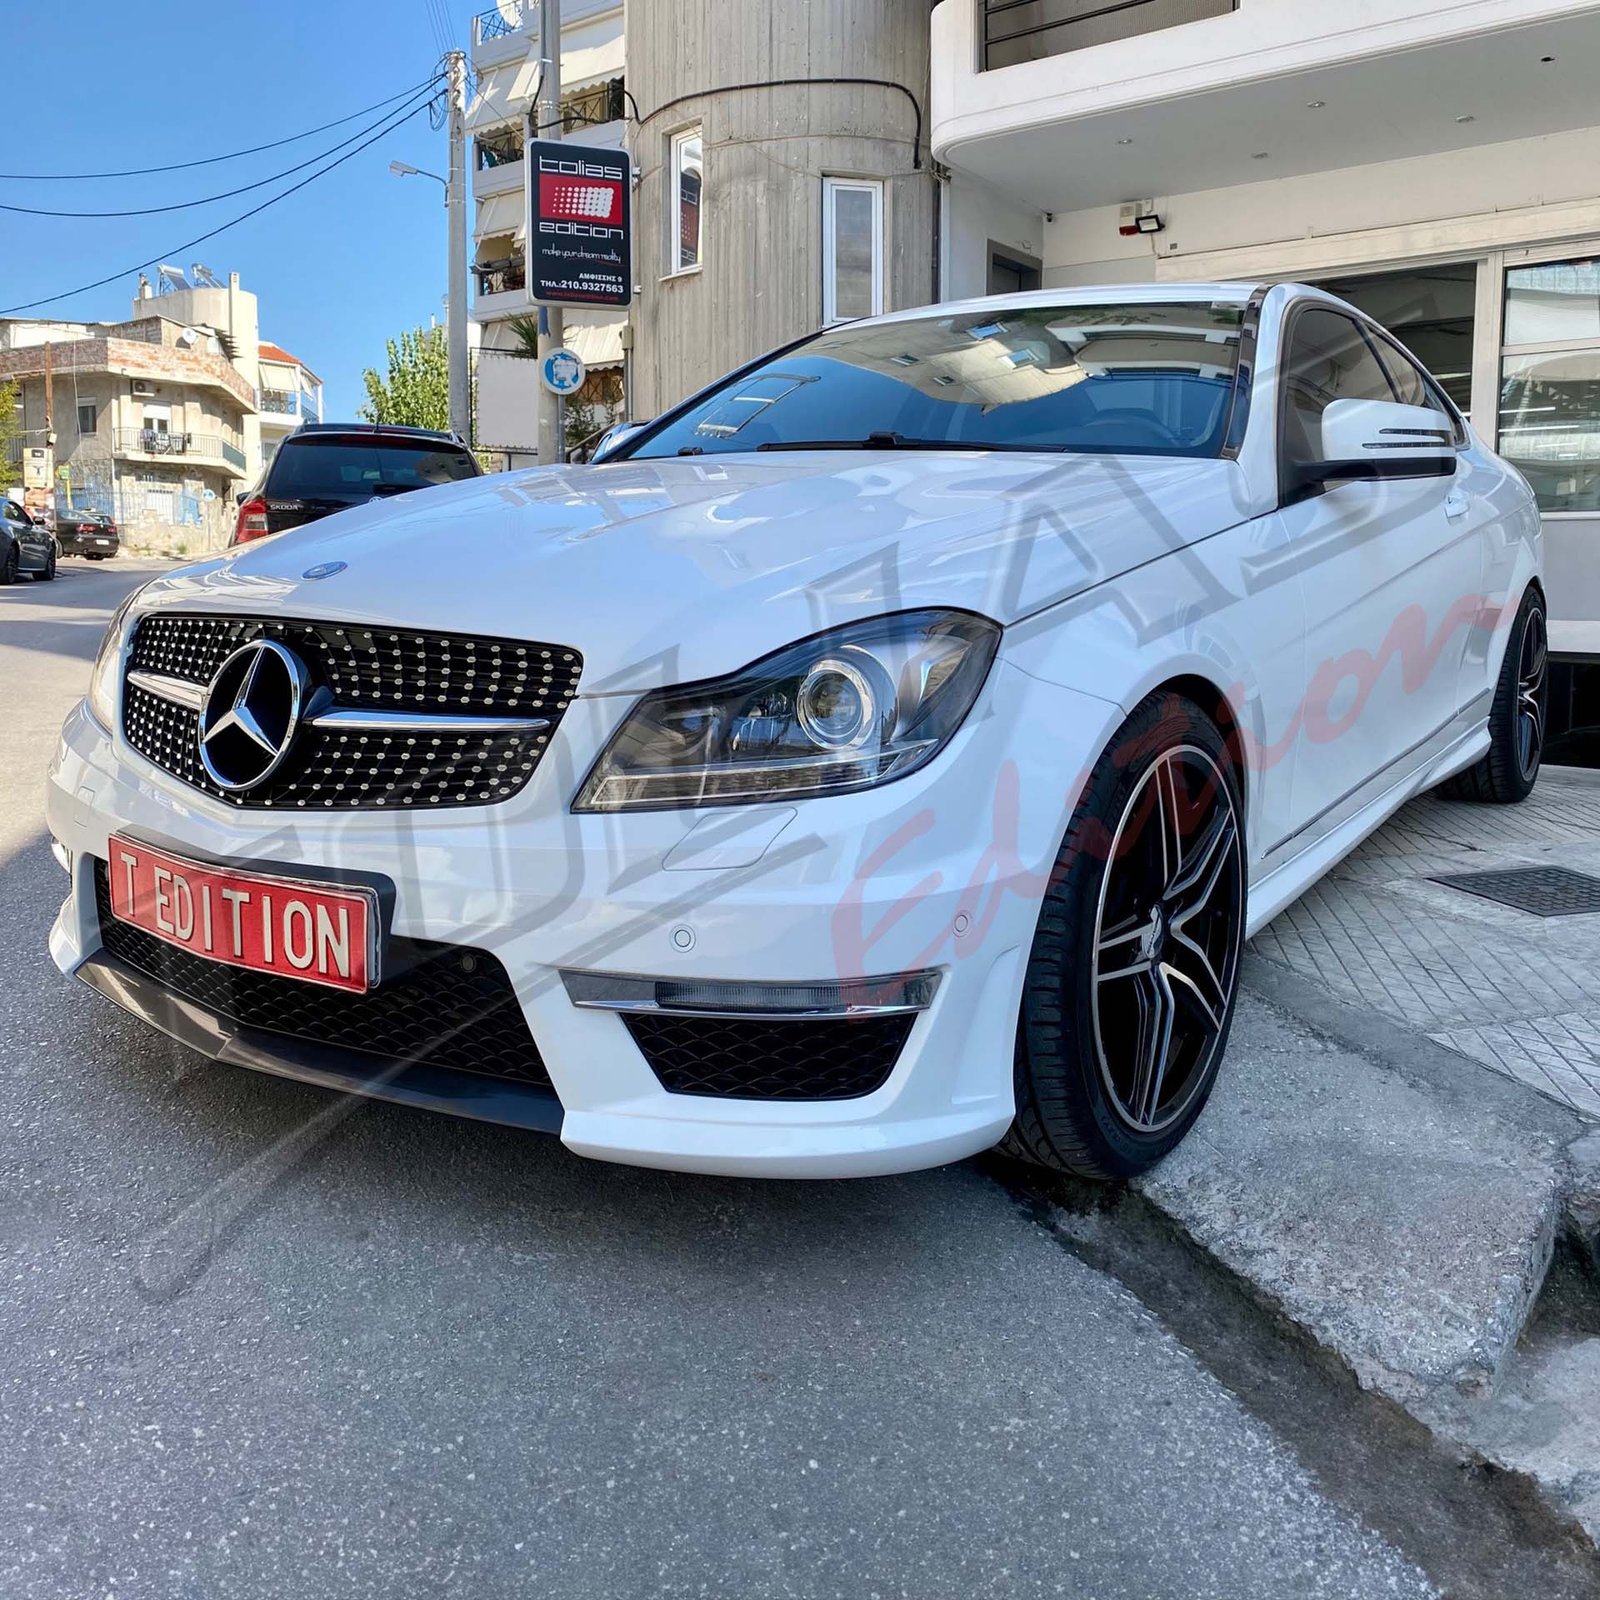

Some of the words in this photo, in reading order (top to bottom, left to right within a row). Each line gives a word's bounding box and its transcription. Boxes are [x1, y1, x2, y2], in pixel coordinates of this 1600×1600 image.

[539, 155, 623, 180] tolias
[539, 221, 624, 240] edition
[120, 851, 138, 917] T
[153, 865, 350, 978] EDITION
